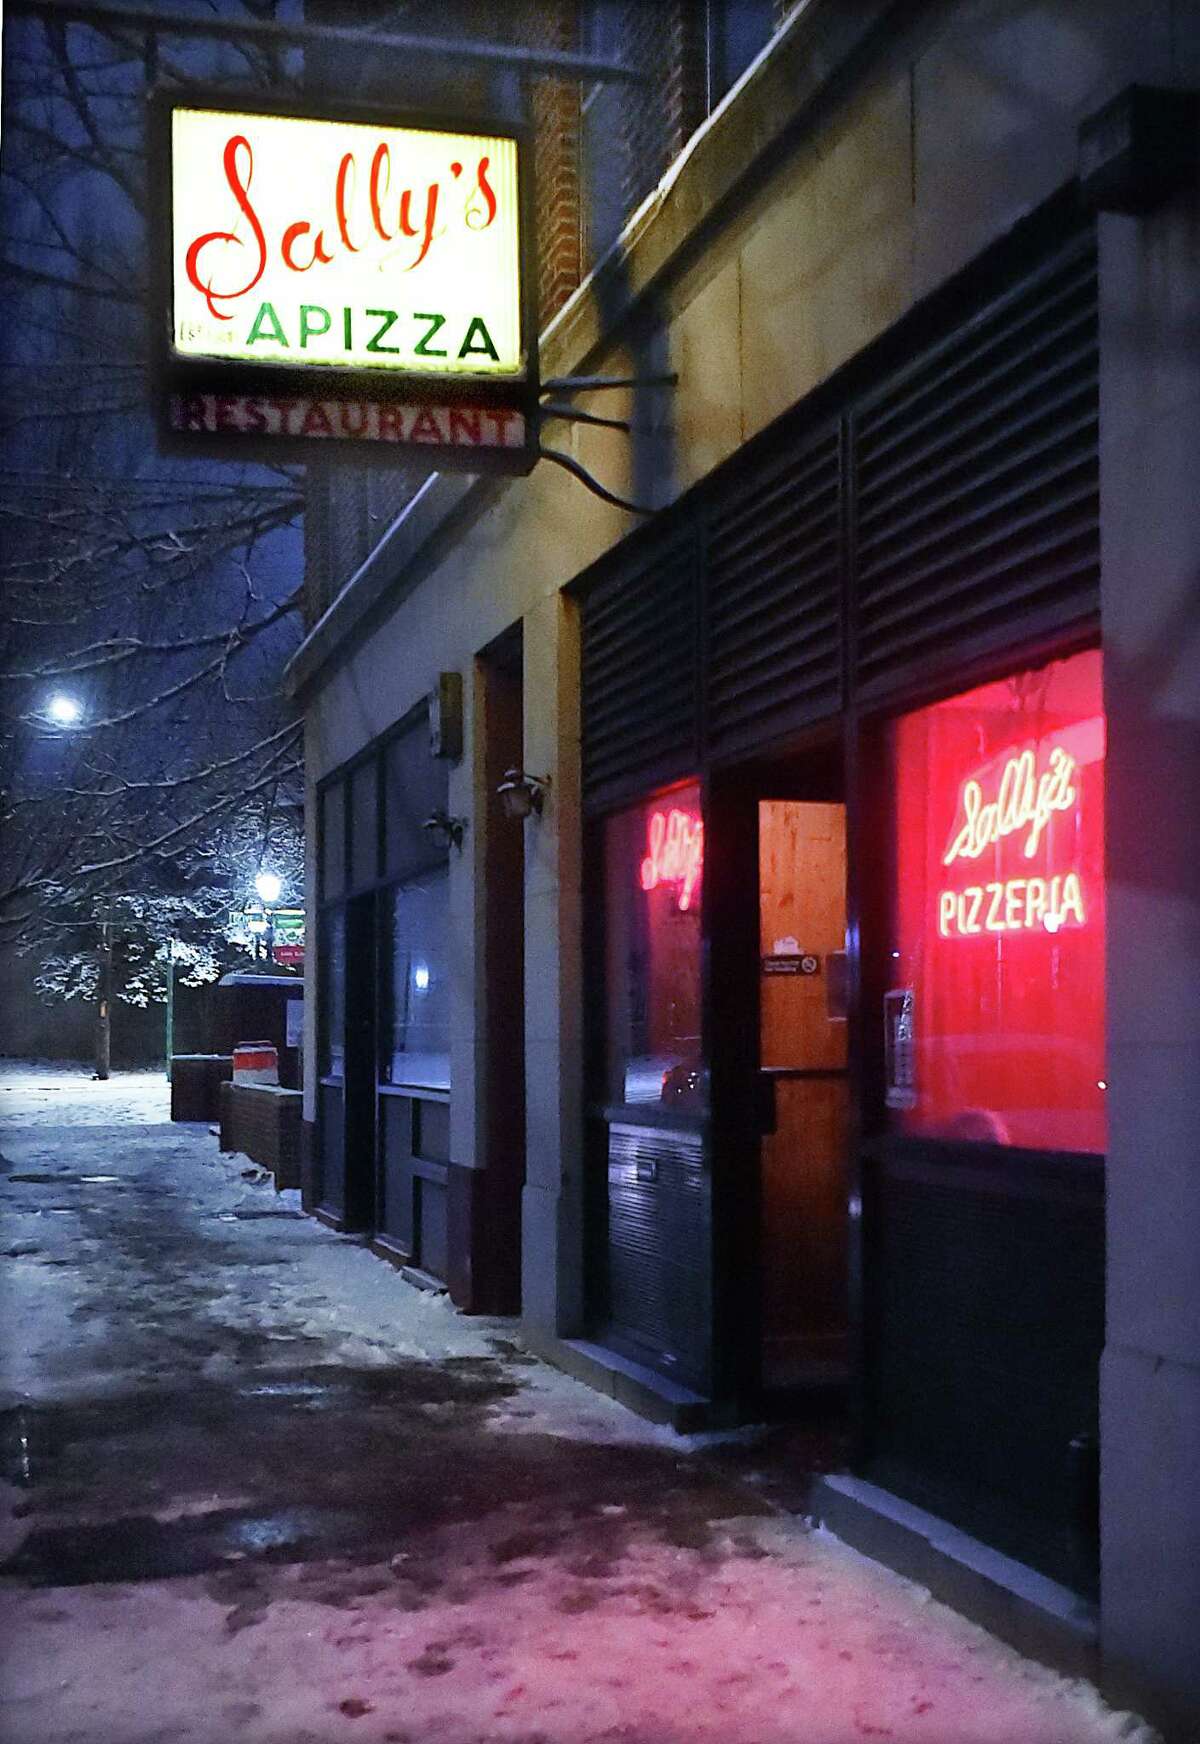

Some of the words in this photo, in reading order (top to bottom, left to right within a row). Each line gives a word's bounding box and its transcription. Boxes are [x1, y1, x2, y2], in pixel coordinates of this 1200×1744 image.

[185, 135, 497, 320] Sally's
[245, 303, 500, 362] APIZZA
[170, 396, 522, 446] RESTAURANT
[943, 747, 1076, 866] Sally's
[939, 873, 1086, 936] PIZZERIA
